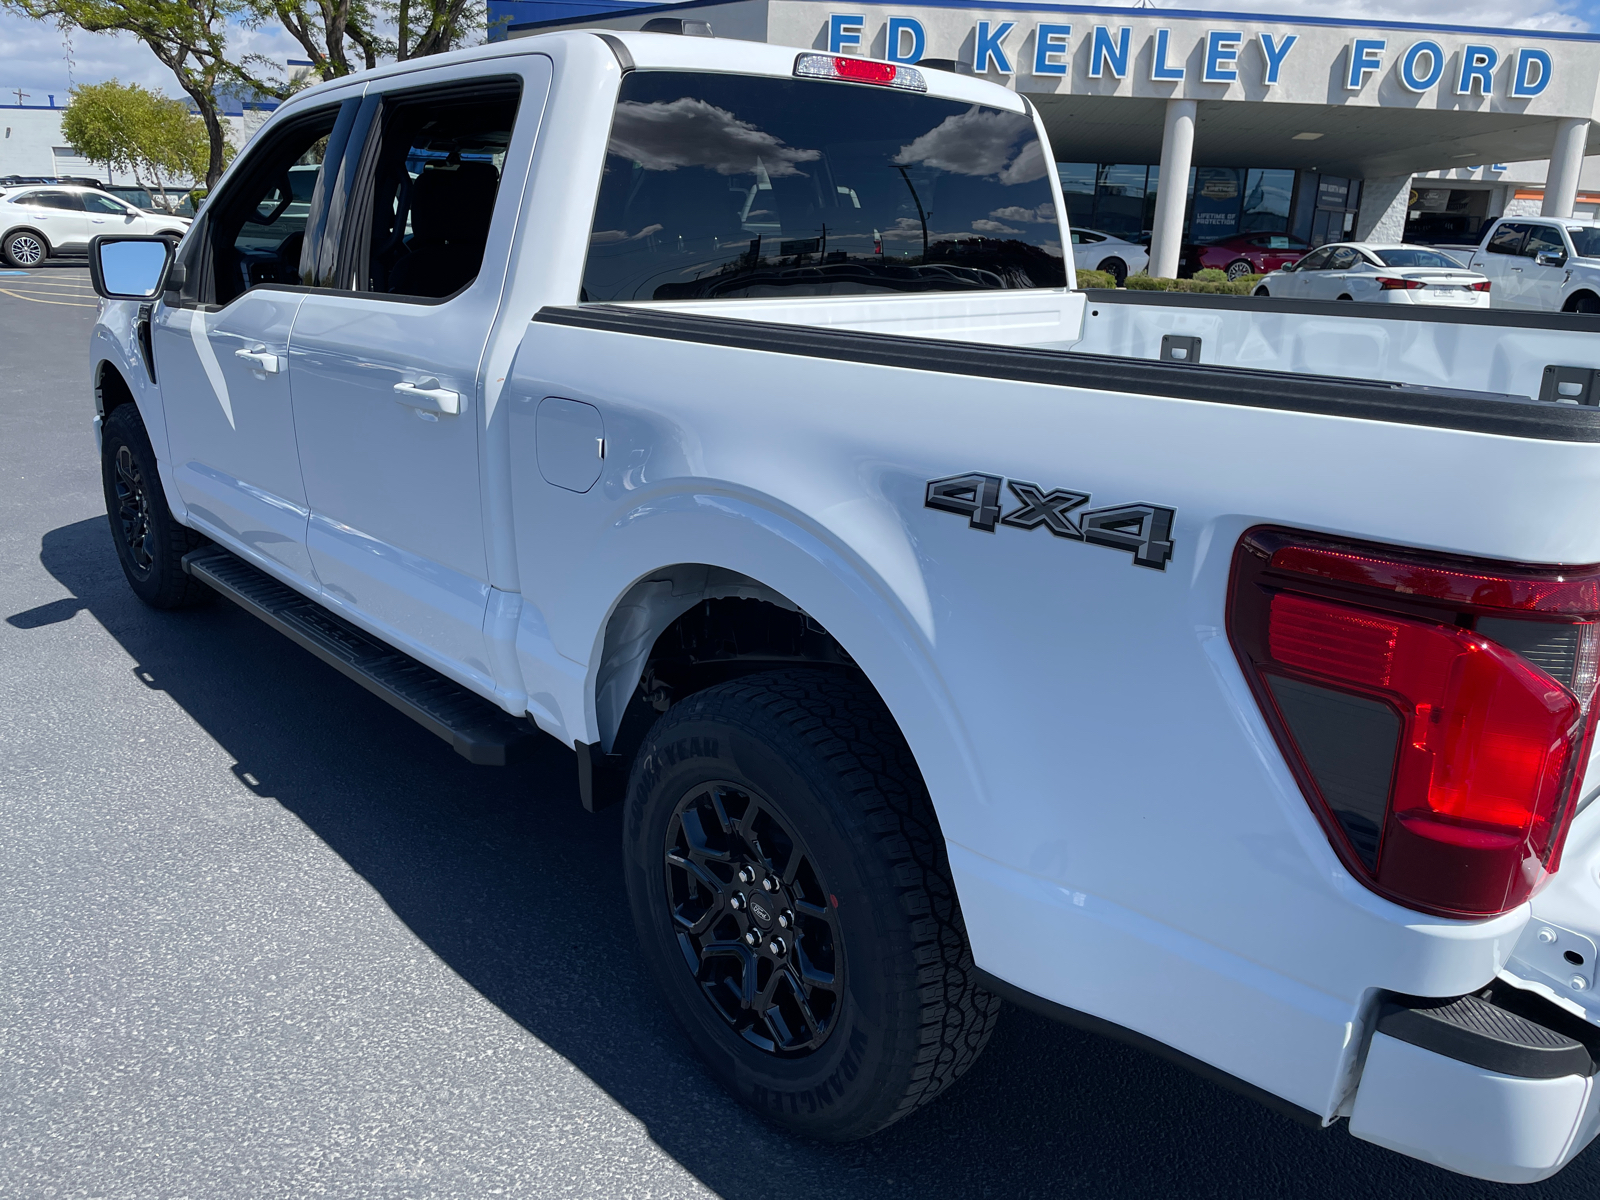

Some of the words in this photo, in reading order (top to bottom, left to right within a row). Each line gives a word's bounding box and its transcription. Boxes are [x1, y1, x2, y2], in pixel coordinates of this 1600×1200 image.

[828, 12, 927, 65] ED
[973, 20, 1300, 86] KENLEY
[1344, 37, 1553, 98] FORD
[752, 903, 769, 920] Ford
[752, 1024, 869, 1115] WRANGLER
